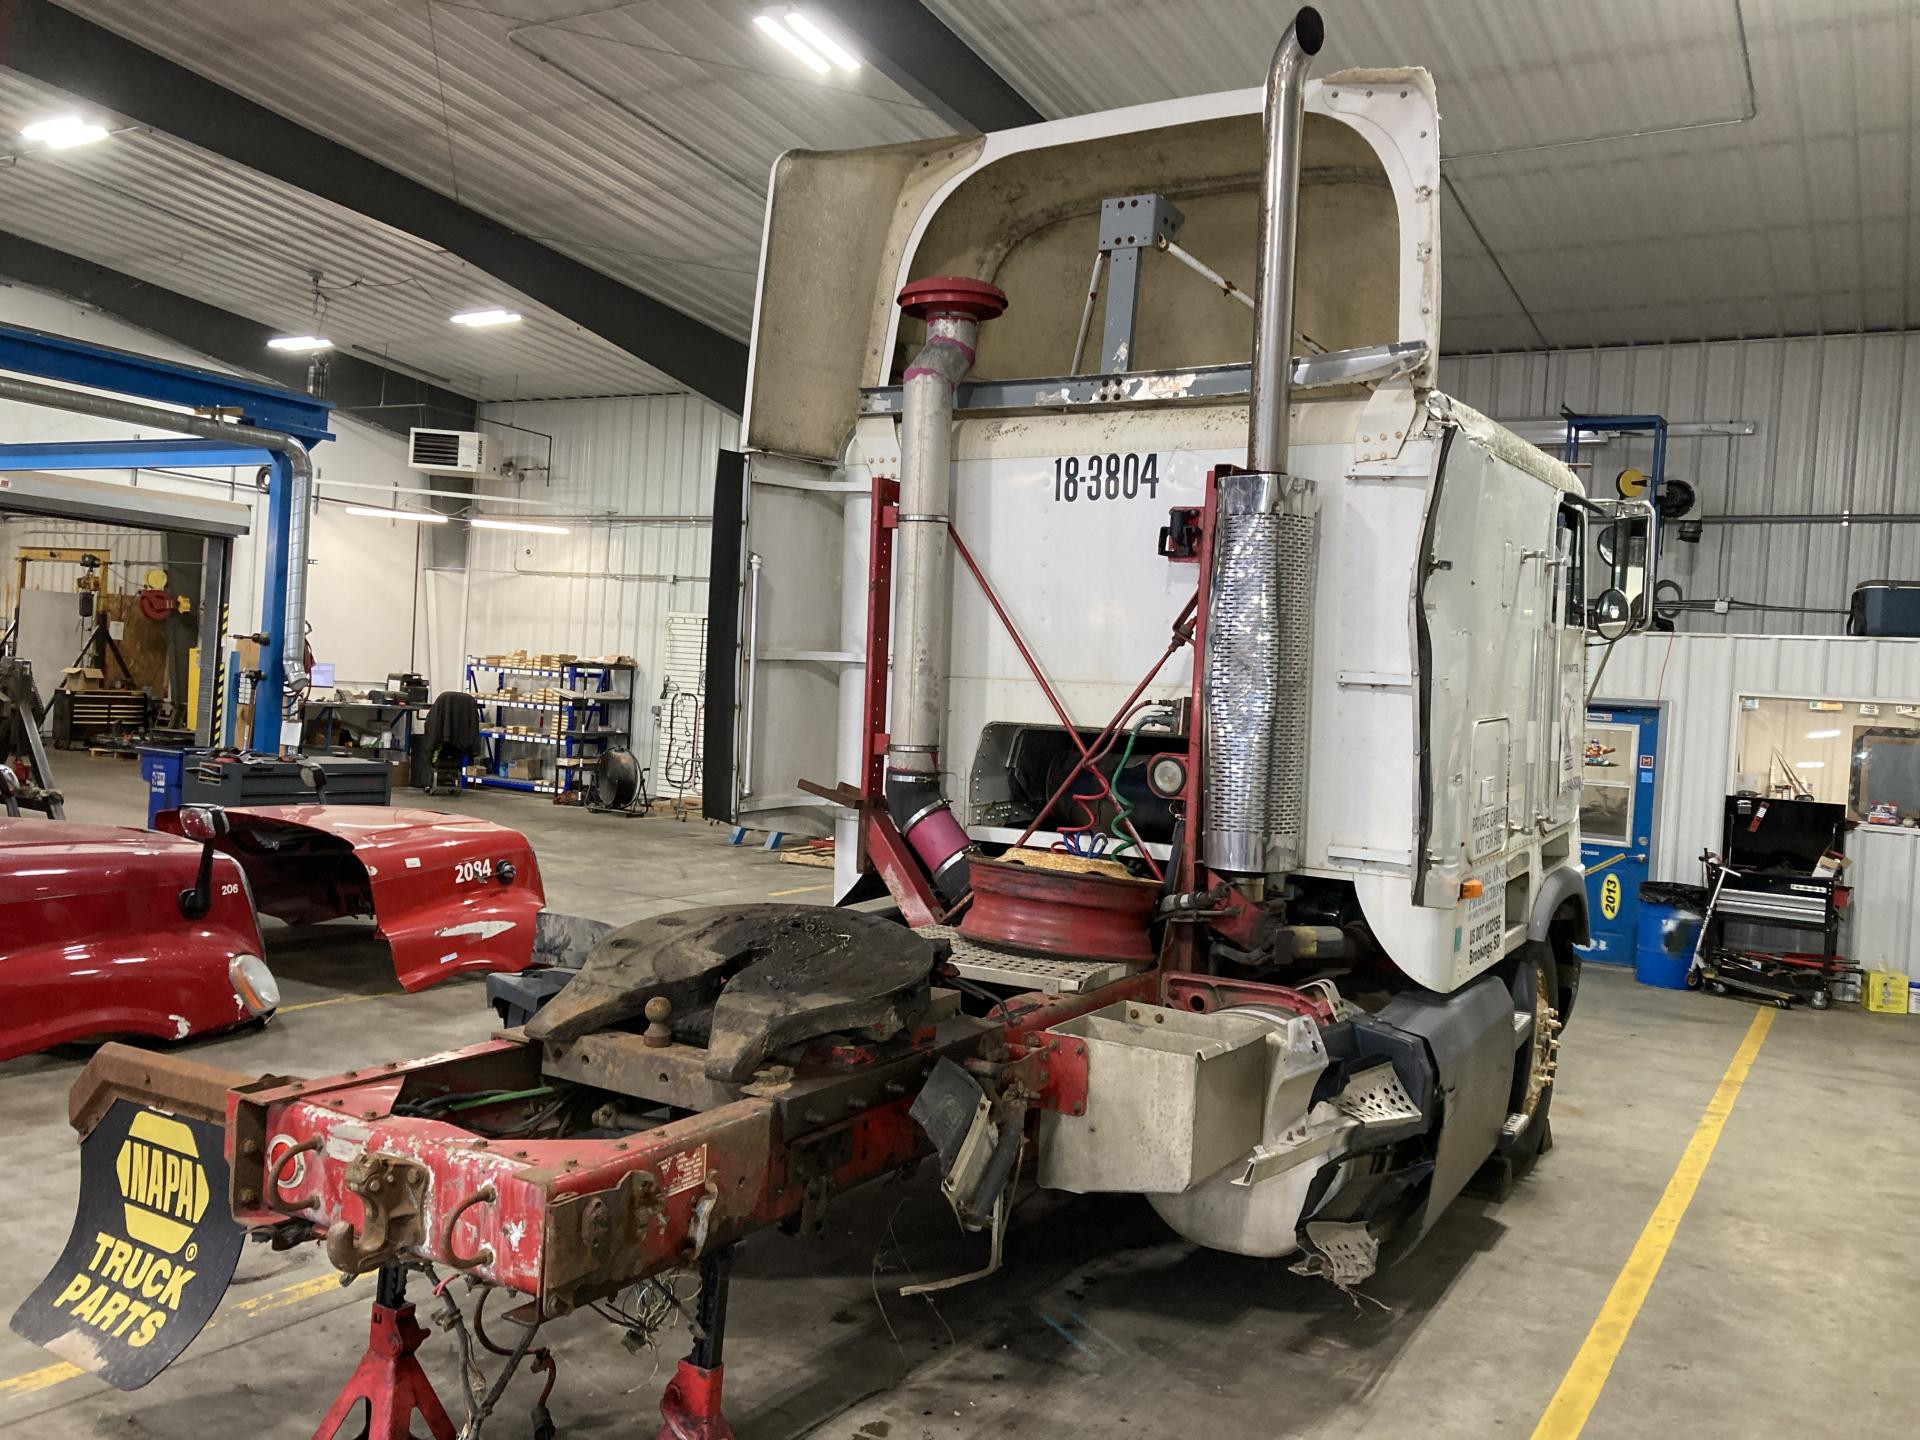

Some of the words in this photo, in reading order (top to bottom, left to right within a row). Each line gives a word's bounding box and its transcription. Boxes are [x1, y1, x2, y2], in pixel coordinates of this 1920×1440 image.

[1054, 452, 1160, 502] 18-3804
[221, 883, 239, 896] 206
[1605, 879, 1617, 914] 2013
[130, 1142, 194, 1224] NAPA
[88, 1231, 196, 1311] TRUCK
[52, 1273, 167, 1348] PARTS
